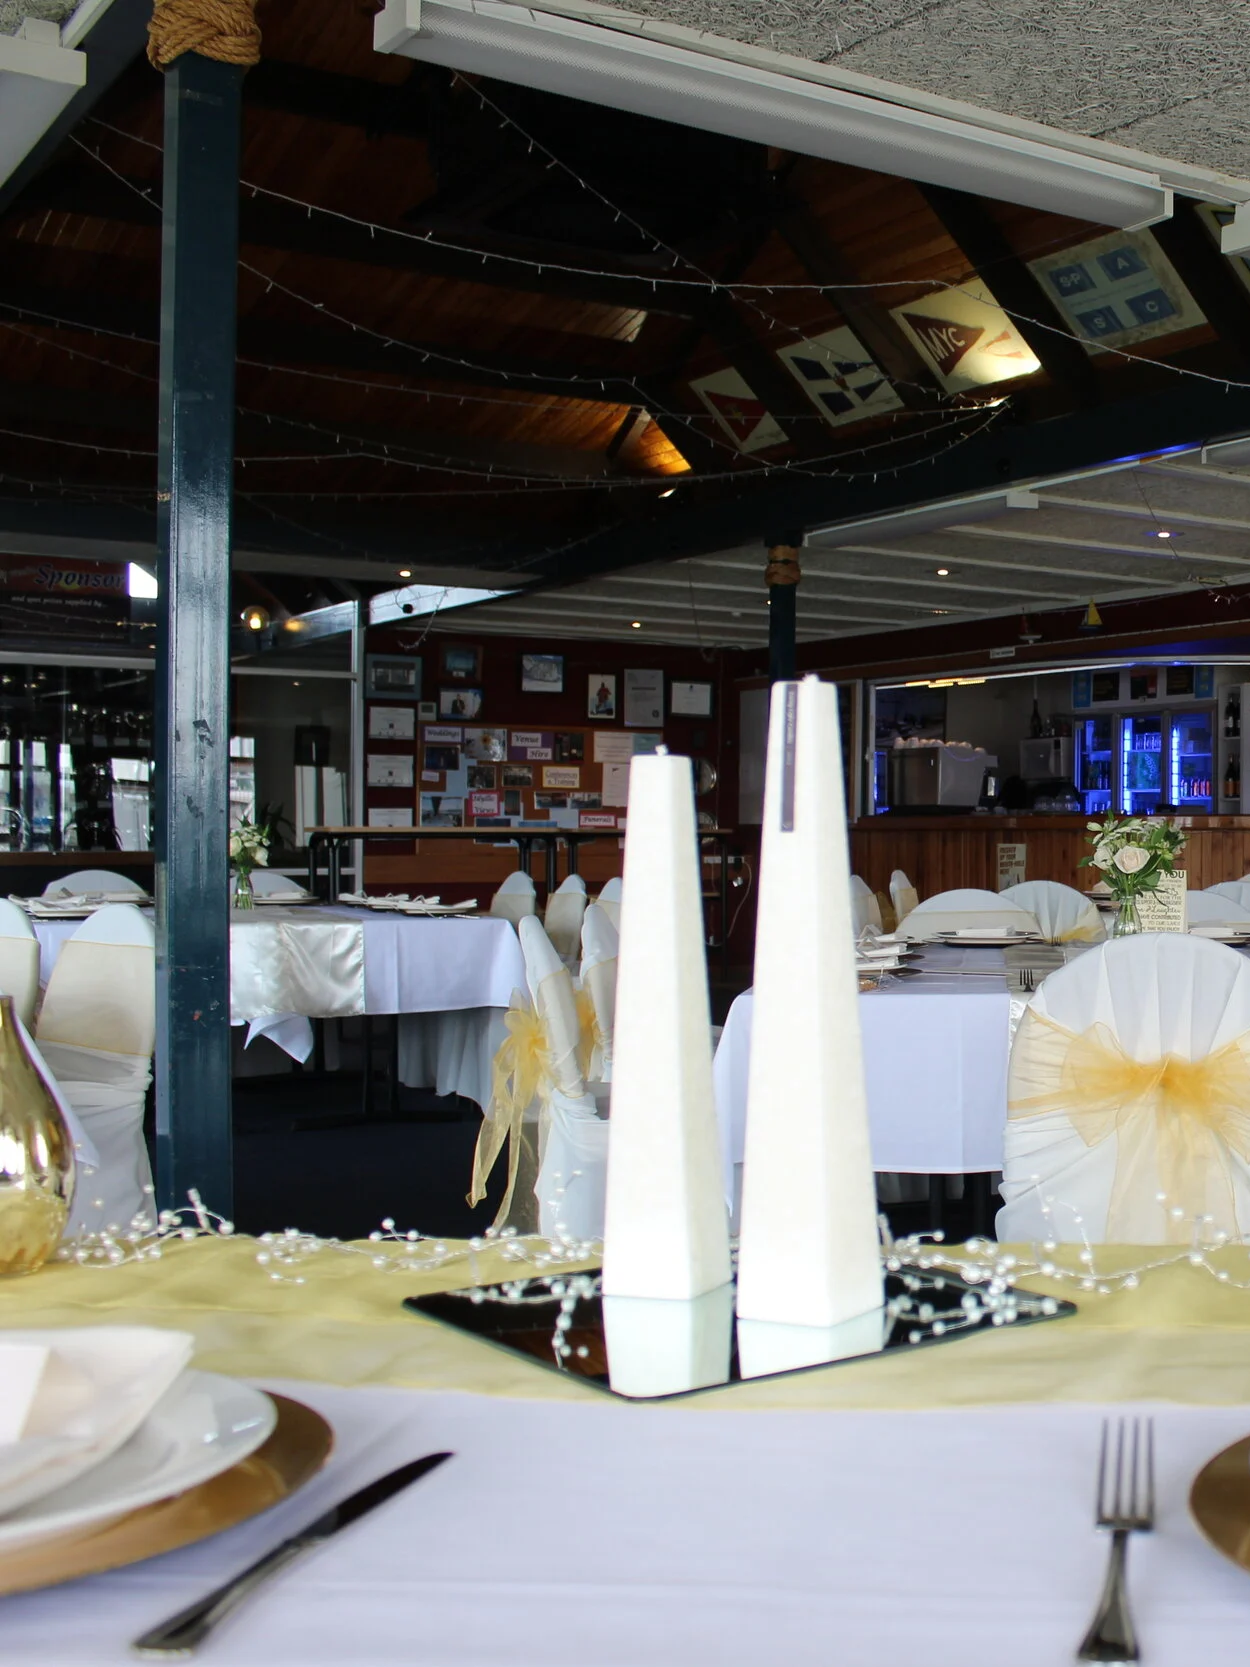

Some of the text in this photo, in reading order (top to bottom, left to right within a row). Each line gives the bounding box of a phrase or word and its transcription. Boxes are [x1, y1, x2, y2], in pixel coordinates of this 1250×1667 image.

[1116, 256, 1130, 270] A
[1145, 300, 1159, 313] C
[916, 327, 966, 362] MYC
[34, 562, 125, 591] Sponsor
[513, 734, 539, 743] Venue
